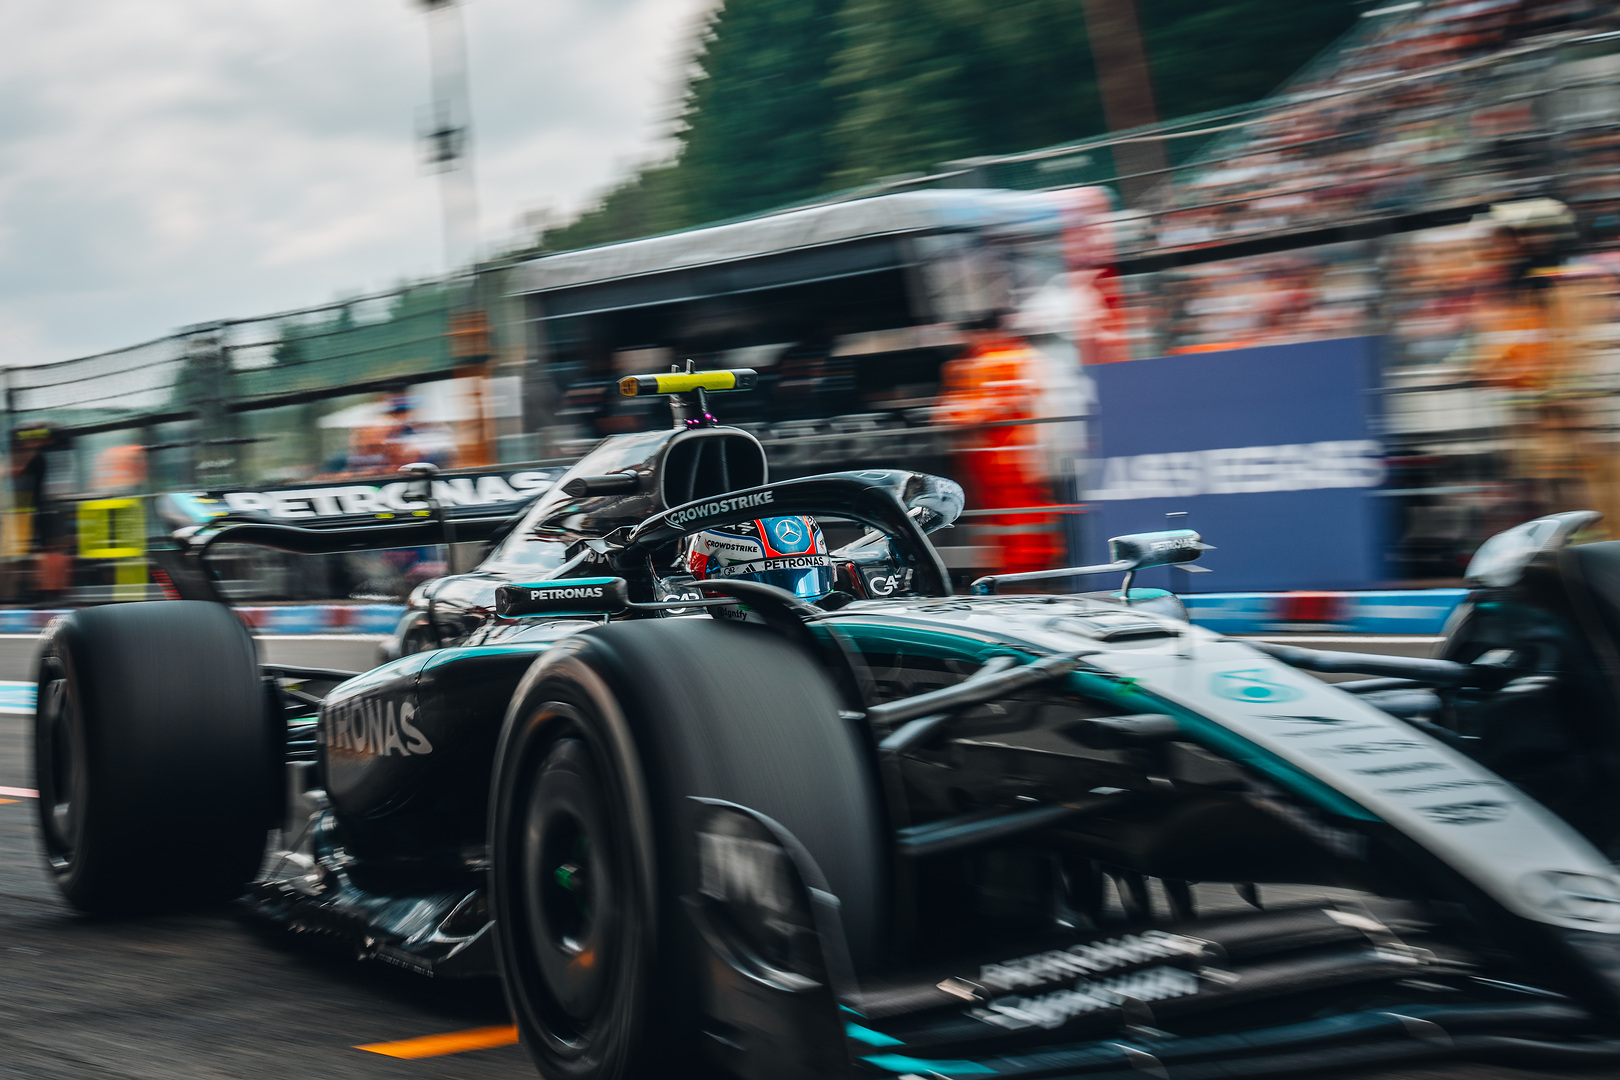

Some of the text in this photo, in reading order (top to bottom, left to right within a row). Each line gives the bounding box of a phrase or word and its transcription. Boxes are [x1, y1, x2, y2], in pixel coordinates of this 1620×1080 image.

[670, 490, 775, 525] CROWDSTRIKE
[706, 539, 758, 553] CROWDSTRIKE
[764, 556, 824, 571] PETRONAS
[530, 587, 604, 601] PETRONAS
